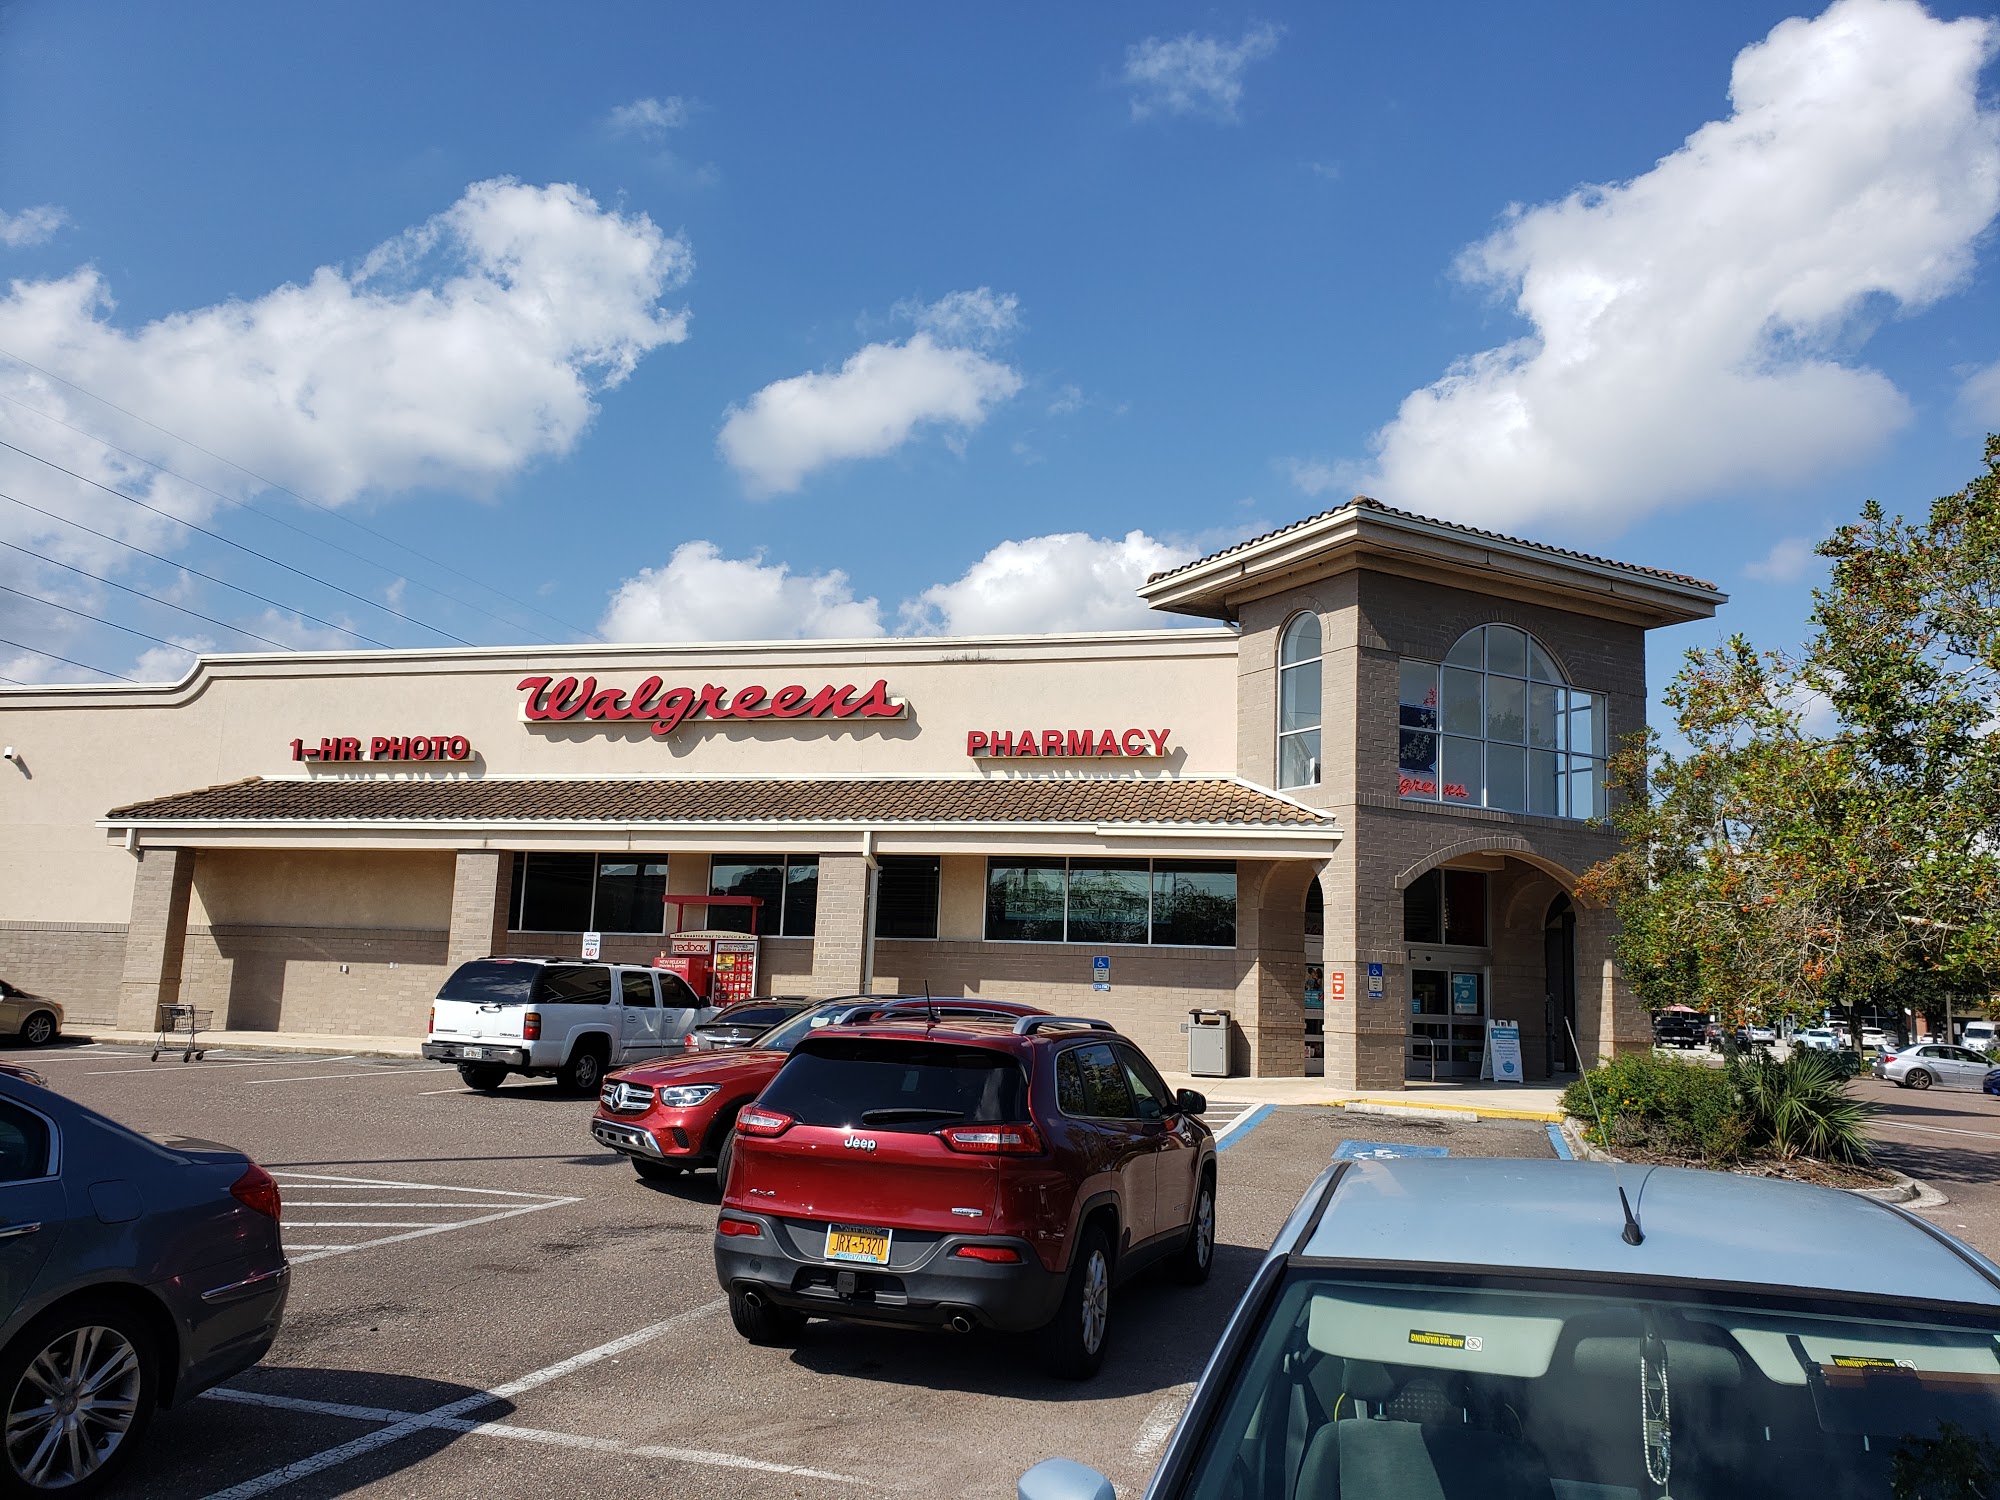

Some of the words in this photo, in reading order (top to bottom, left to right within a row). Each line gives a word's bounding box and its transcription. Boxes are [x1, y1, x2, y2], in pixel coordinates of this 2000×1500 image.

[517, 676, 903, 736] Walgreens
[290, 737, 361, 761] 1-HR
[370, 735, 470, 760] PHOTO
[967, 729, 1171, 756] PHARMACY
[844, 1135, 877, 1152] Jeep
